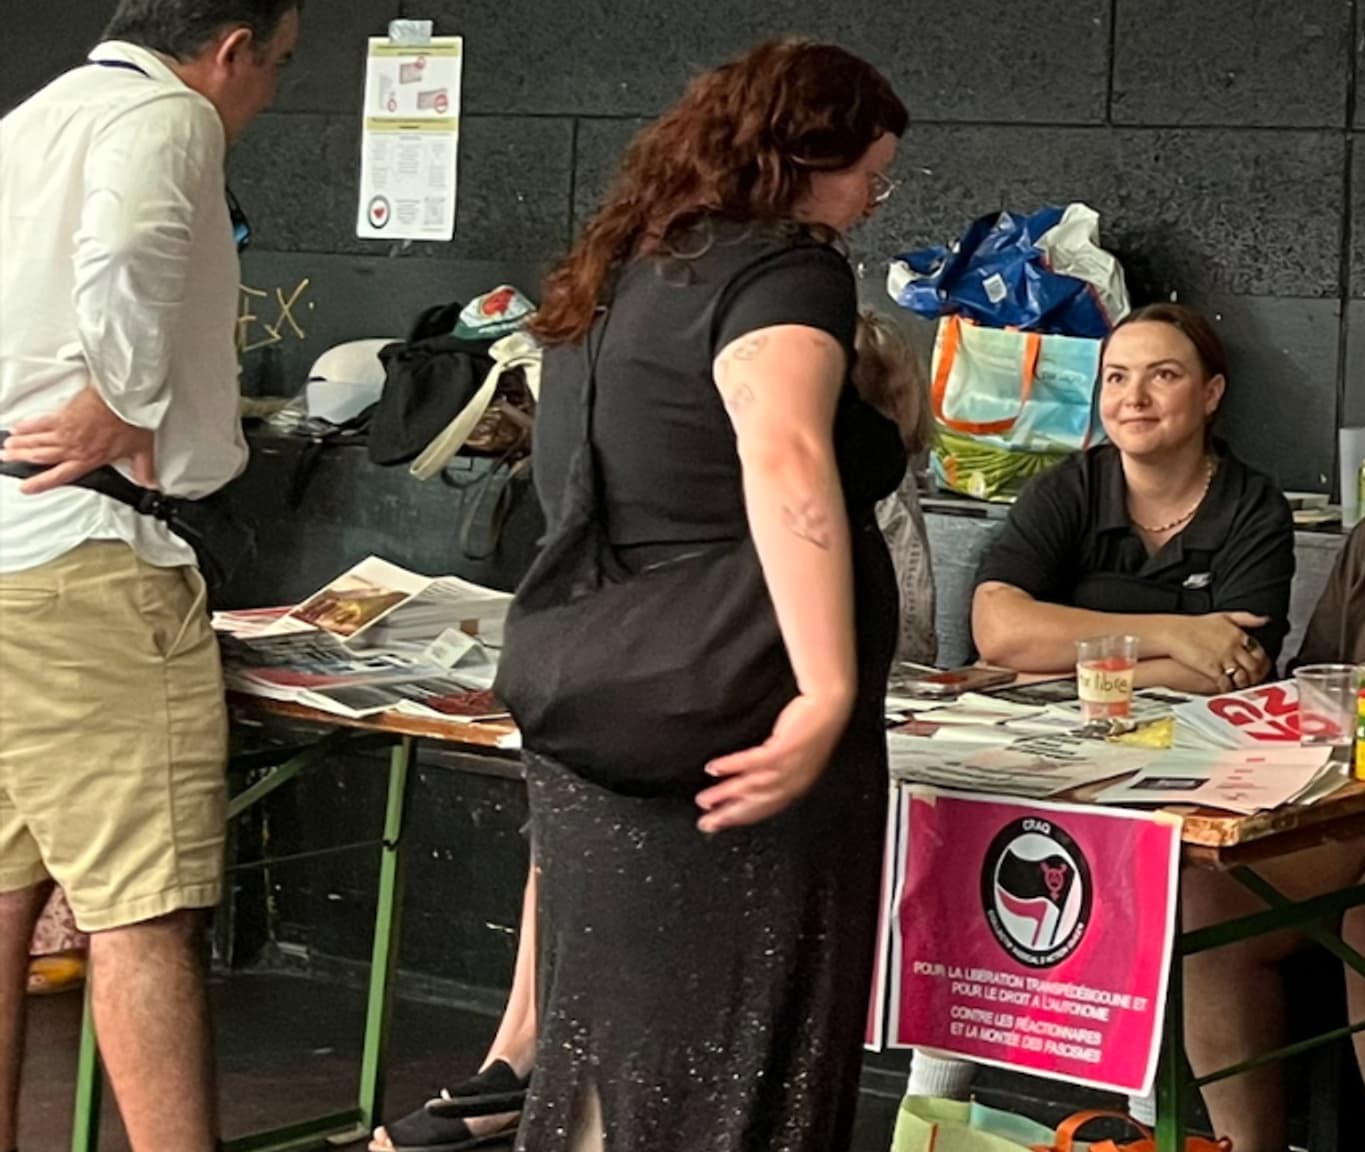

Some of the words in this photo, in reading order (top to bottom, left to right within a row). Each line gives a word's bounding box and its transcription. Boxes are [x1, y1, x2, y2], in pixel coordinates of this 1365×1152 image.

[914, 961, 945, 977] POUR
[948, 965, 962, 978] LA
[952, 981, 983, 998] POUR
[985, 986, 998, 1000] LE
